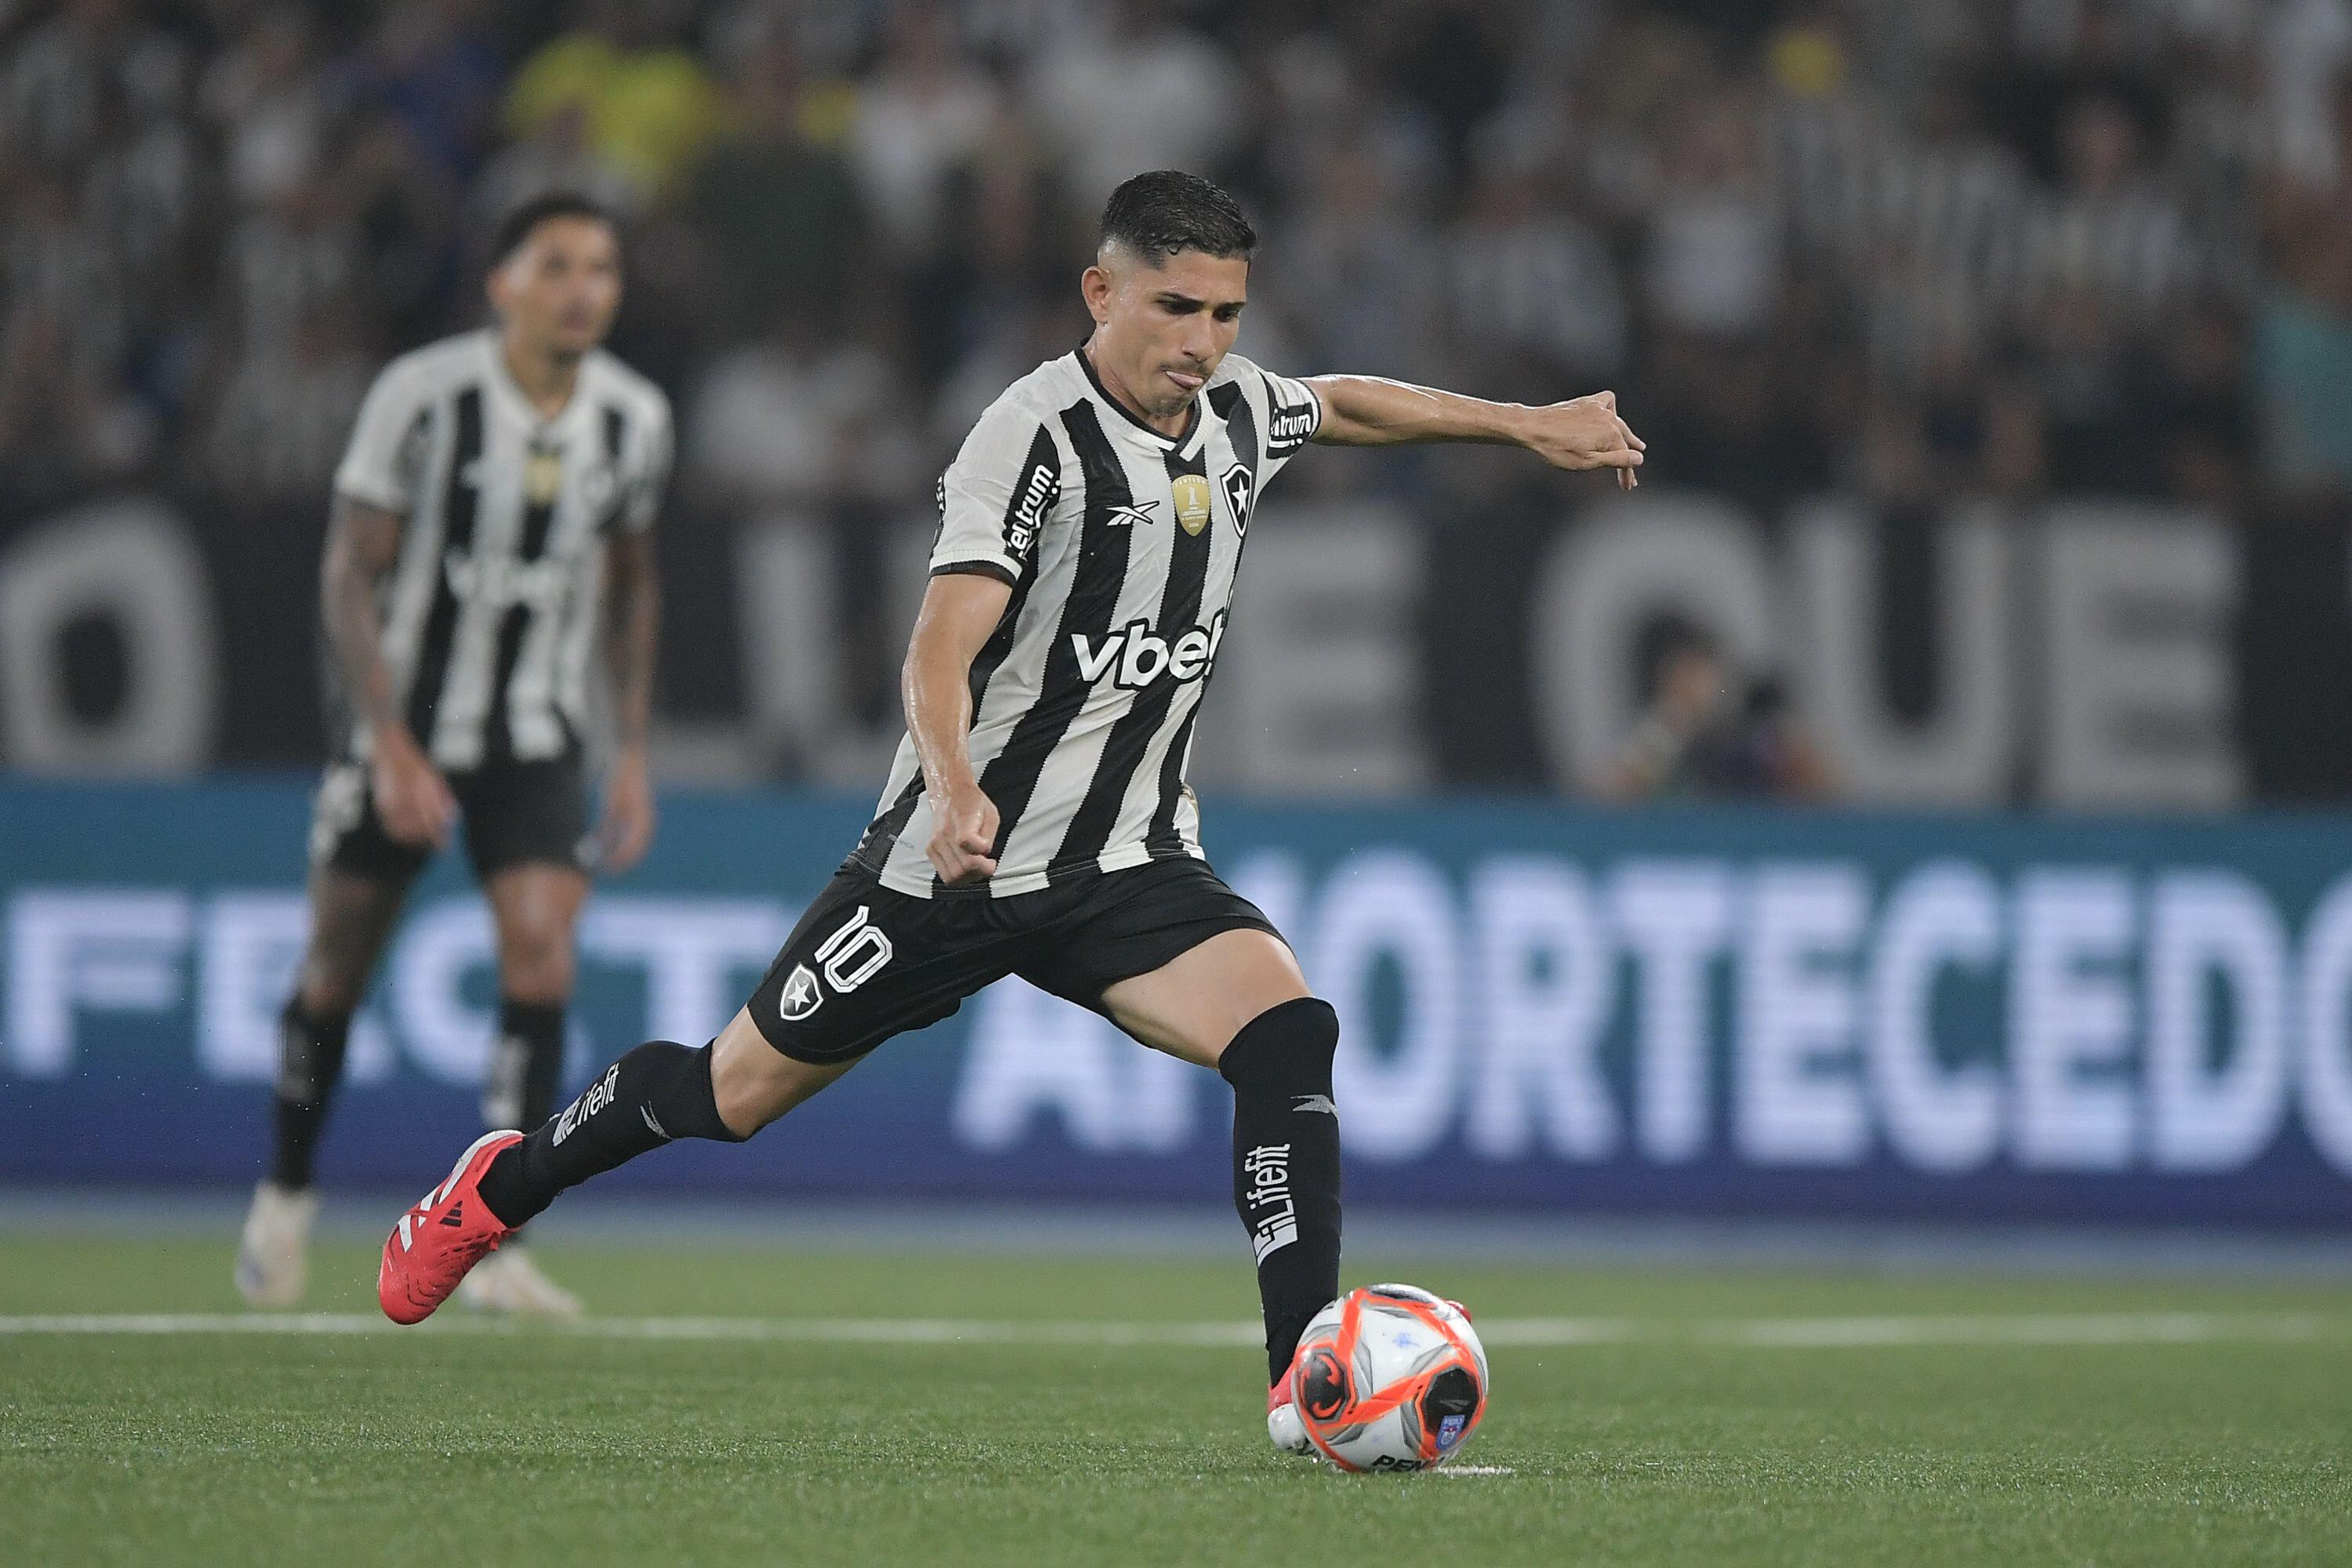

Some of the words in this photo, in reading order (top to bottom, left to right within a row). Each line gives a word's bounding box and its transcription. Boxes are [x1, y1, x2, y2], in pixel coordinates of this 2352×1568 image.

[1006, 464, 1054, 558] entrum
[1533, 498, 2250, 815] QUE
[815, 905, 892, 993] 10
[1244, 1143, 1294, 1229] Lifefit
